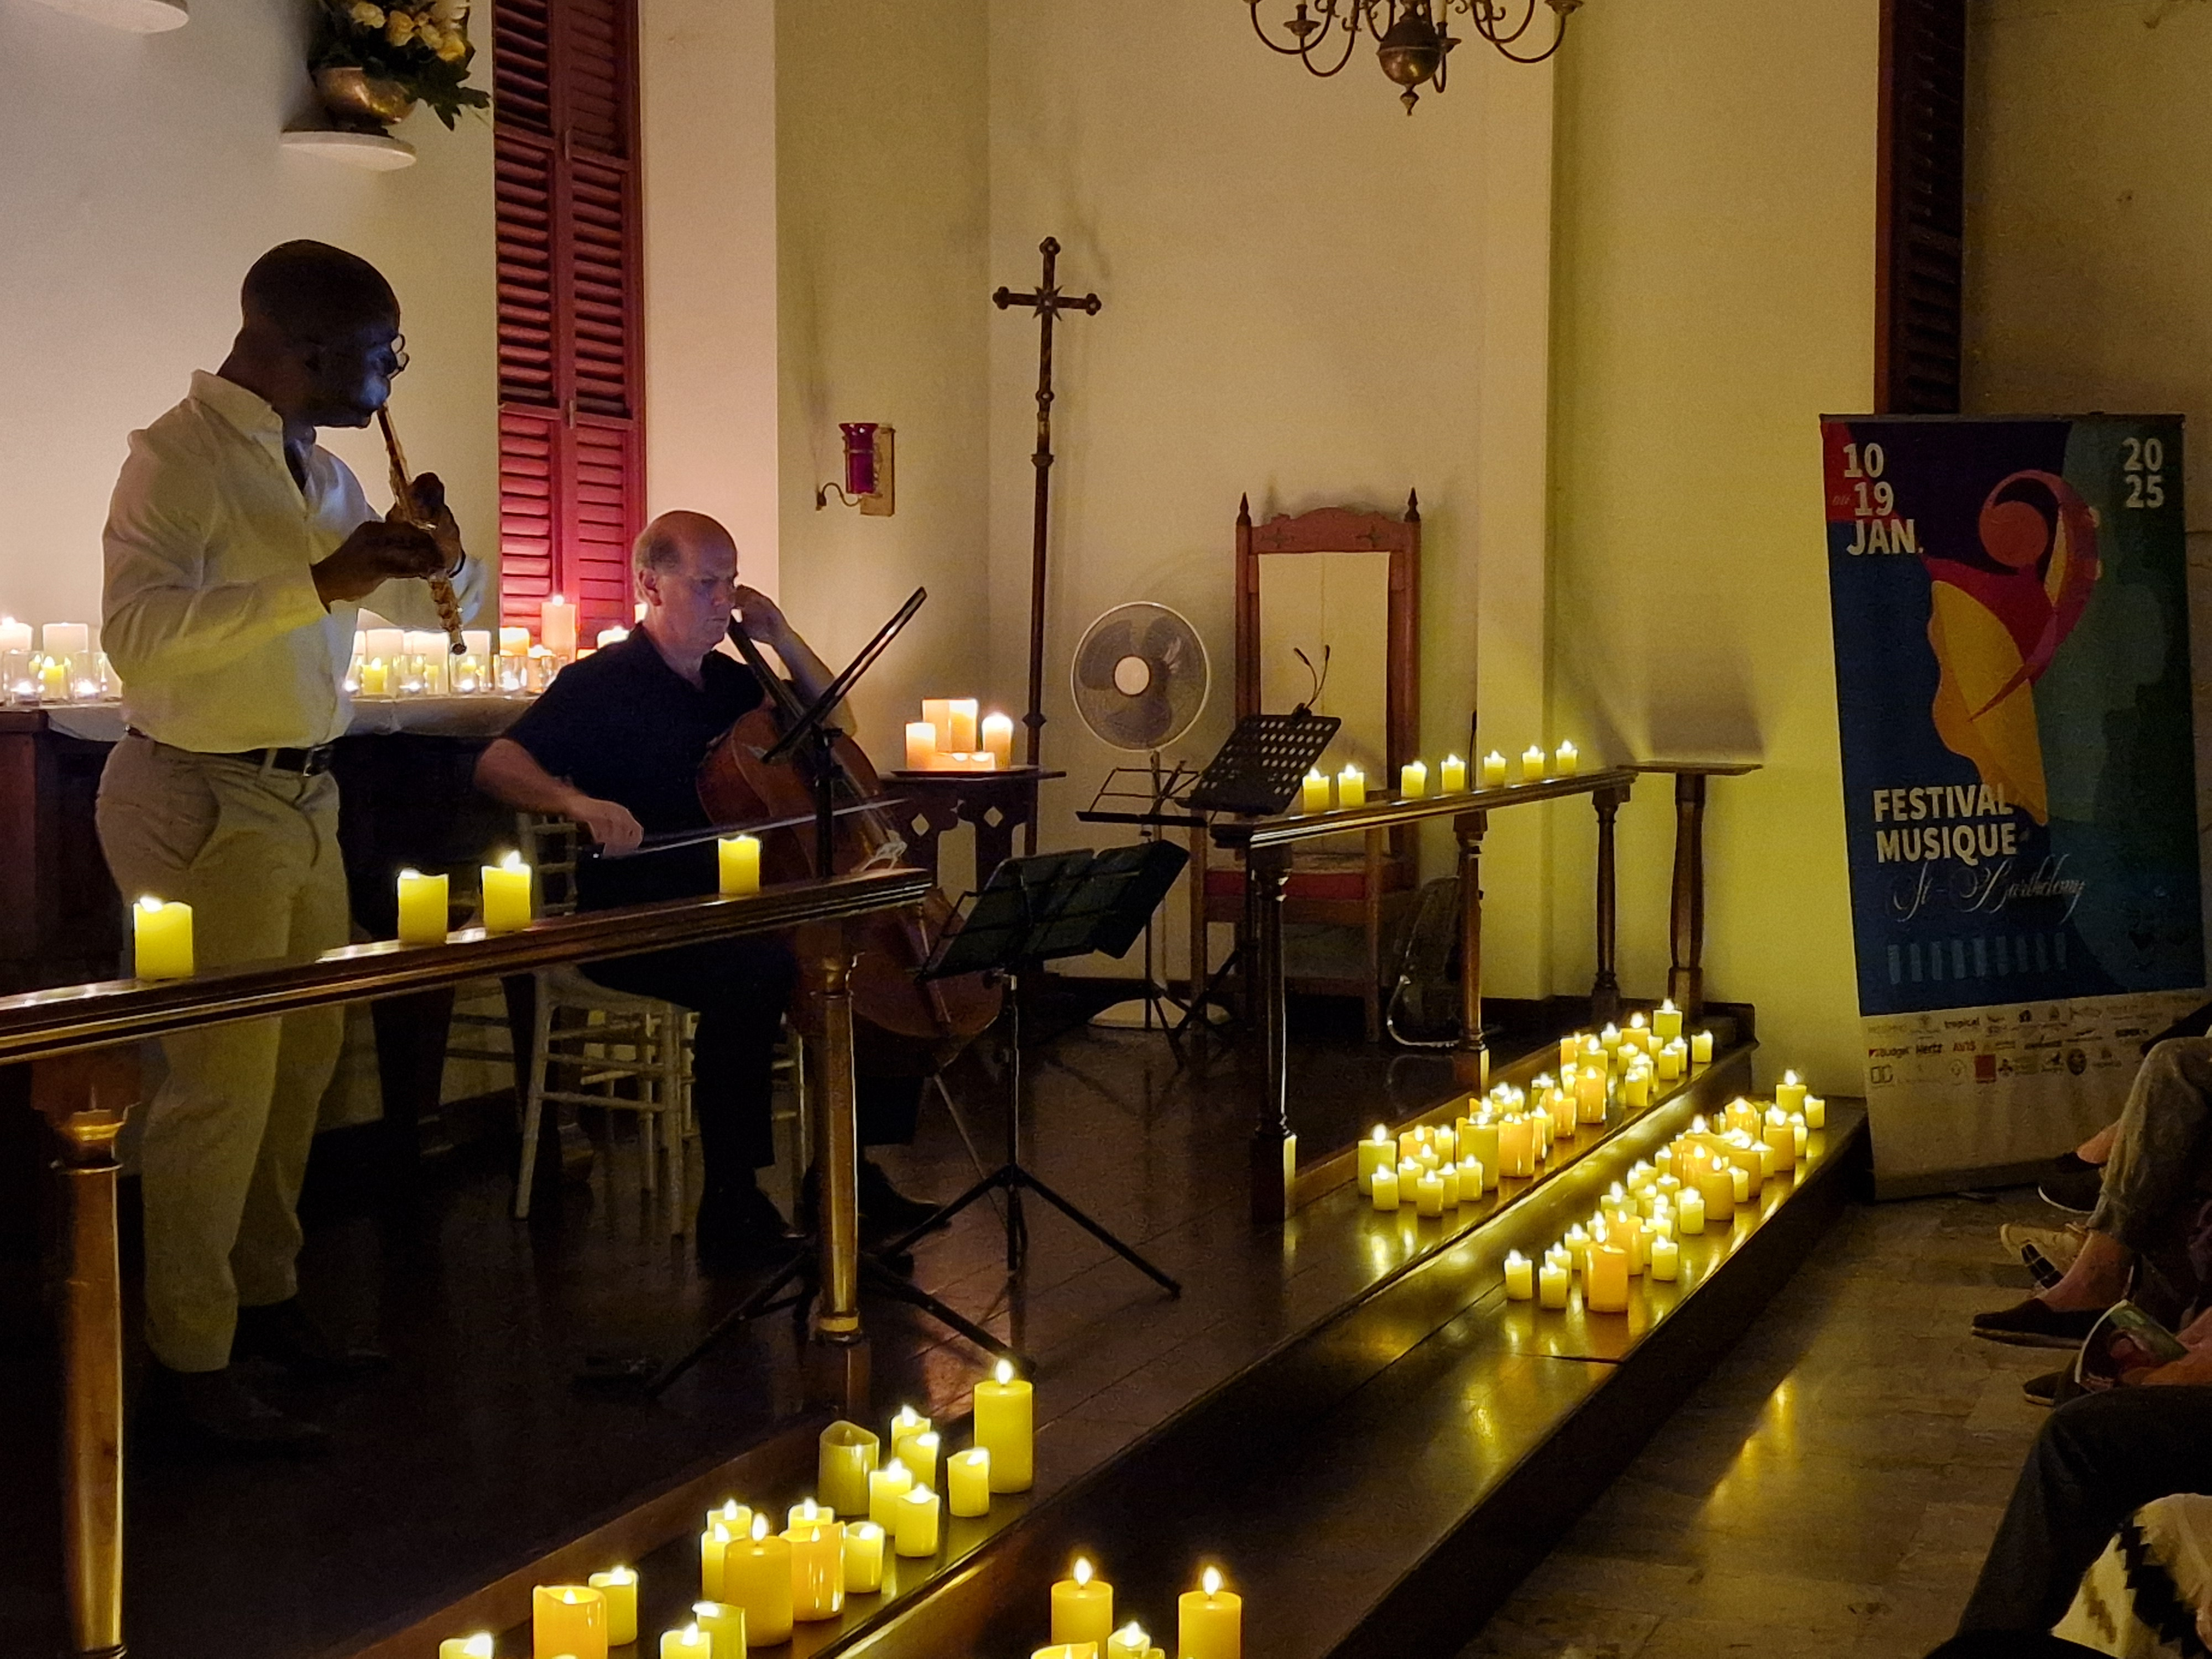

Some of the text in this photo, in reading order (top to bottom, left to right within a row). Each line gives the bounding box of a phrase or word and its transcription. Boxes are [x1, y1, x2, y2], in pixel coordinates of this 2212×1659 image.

[1843, 443, 1884, 477] 10
[2122, 437, 2163, 472] 20
[1854, 481, 1894, 516] 19
[2126, 474, 2164, 508] 25
[1846, 519, 1924, 555] JAN.
[1874, 783, 2014, 822] FESTIVAL
[1876, 822, 2017, 866] MUSIQUE
[1944, 1017, 1980, 1029] tropical
[1916, 1043, 1943, 1053] Hertz
